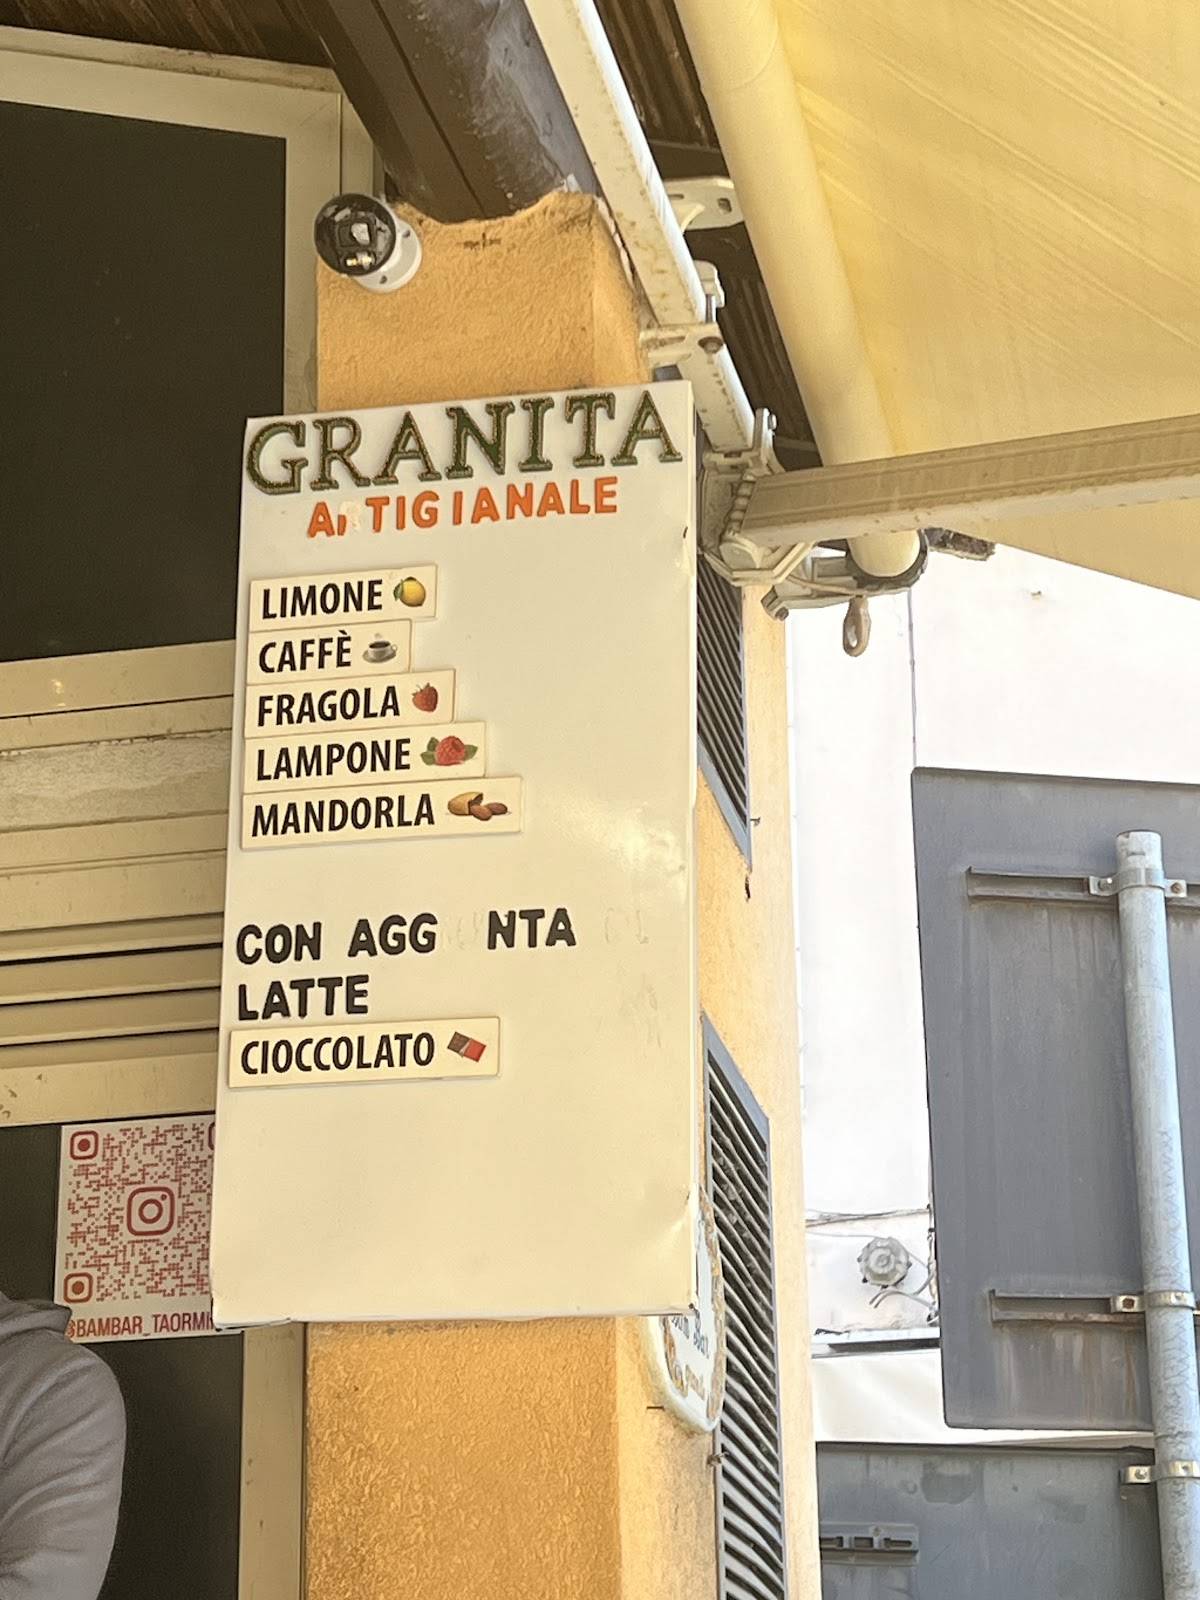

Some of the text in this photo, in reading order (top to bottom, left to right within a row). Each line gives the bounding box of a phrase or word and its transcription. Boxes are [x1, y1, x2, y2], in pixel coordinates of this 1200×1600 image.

[246, 390, 683, 495] GRANITA
[261, 579, 383, 620] LIMONE
[258, 630, 352, 674] CAFFÈ
[257, 686, 400, 727] FRAGOLA
[256, 738, 411, 781] LAMPONE
[251, 793, 435, 838] MANDORLA
[236, 921, 322, 965] CON
[238, 975, 370, 1020] LATTE
[241, 1032, 435, 1075] CIOCCOLATO
